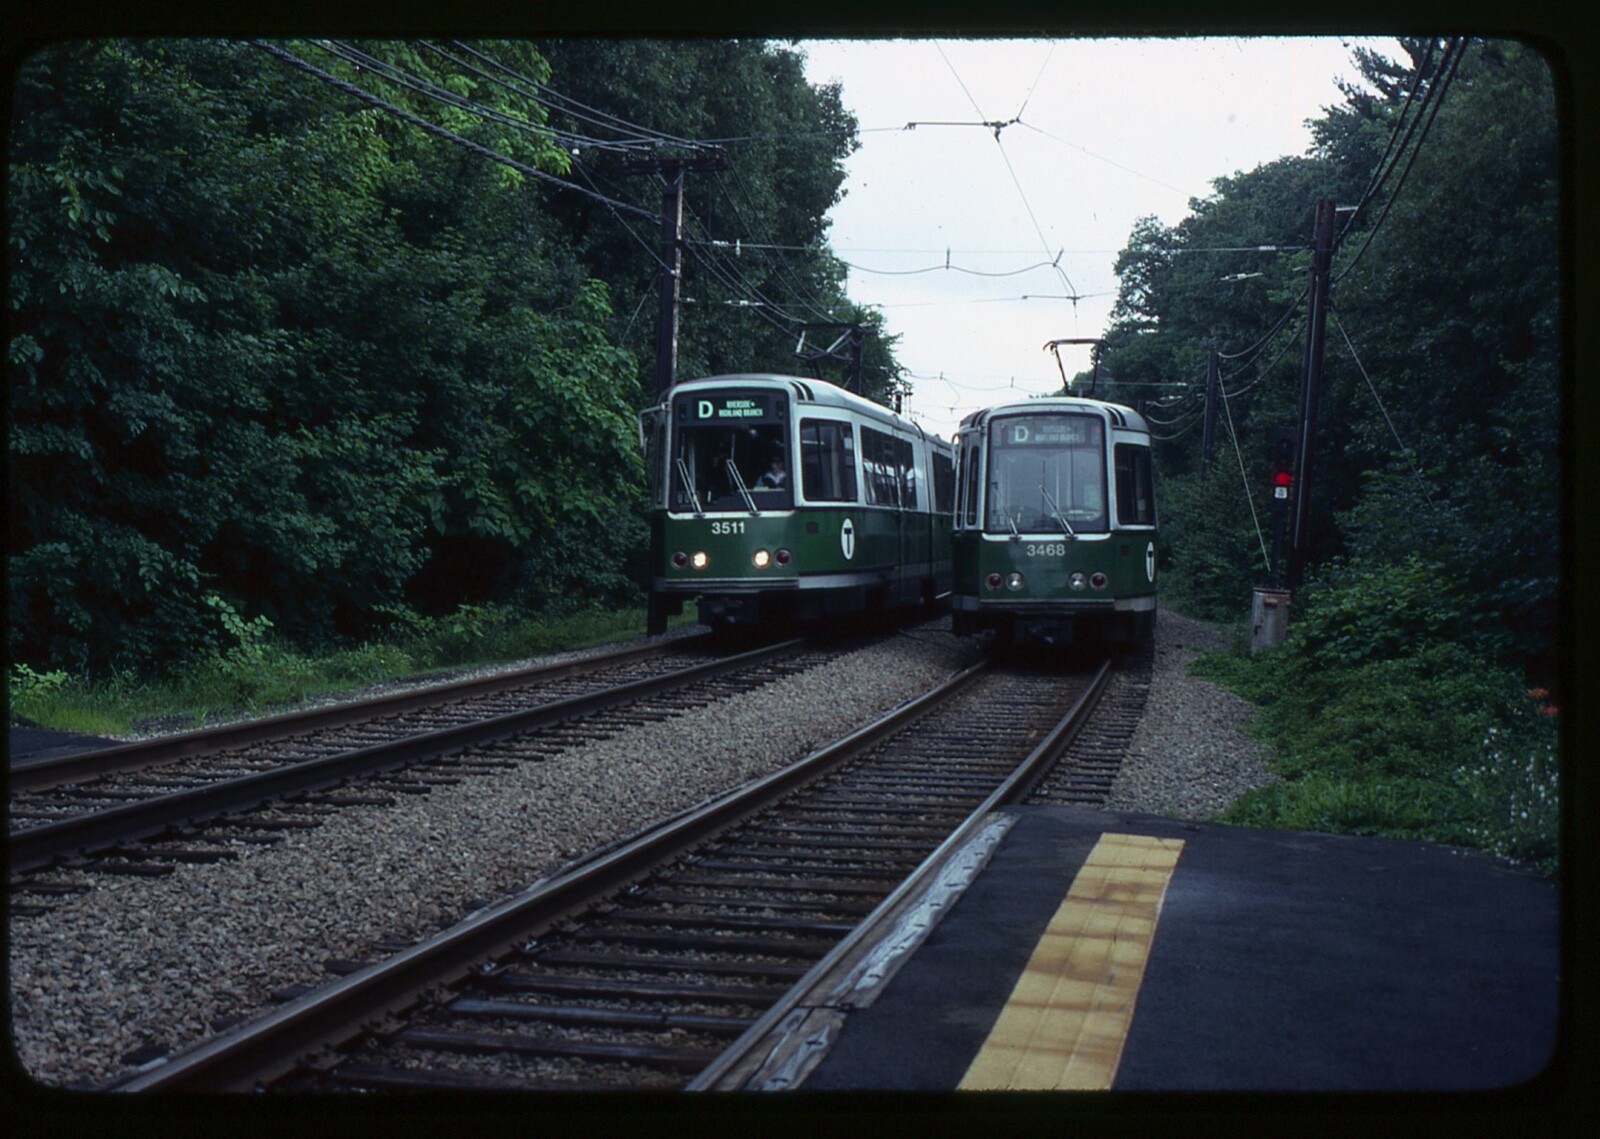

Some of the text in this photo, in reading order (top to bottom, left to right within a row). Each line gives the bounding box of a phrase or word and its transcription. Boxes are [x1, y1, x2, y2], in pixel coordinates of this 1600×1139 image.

[698, 400, 714, 419] D
[1014, 425, 1029, 442] D
[711, 521, 745, 534] 3511
[1027, 544, 1066, 557] 3468
